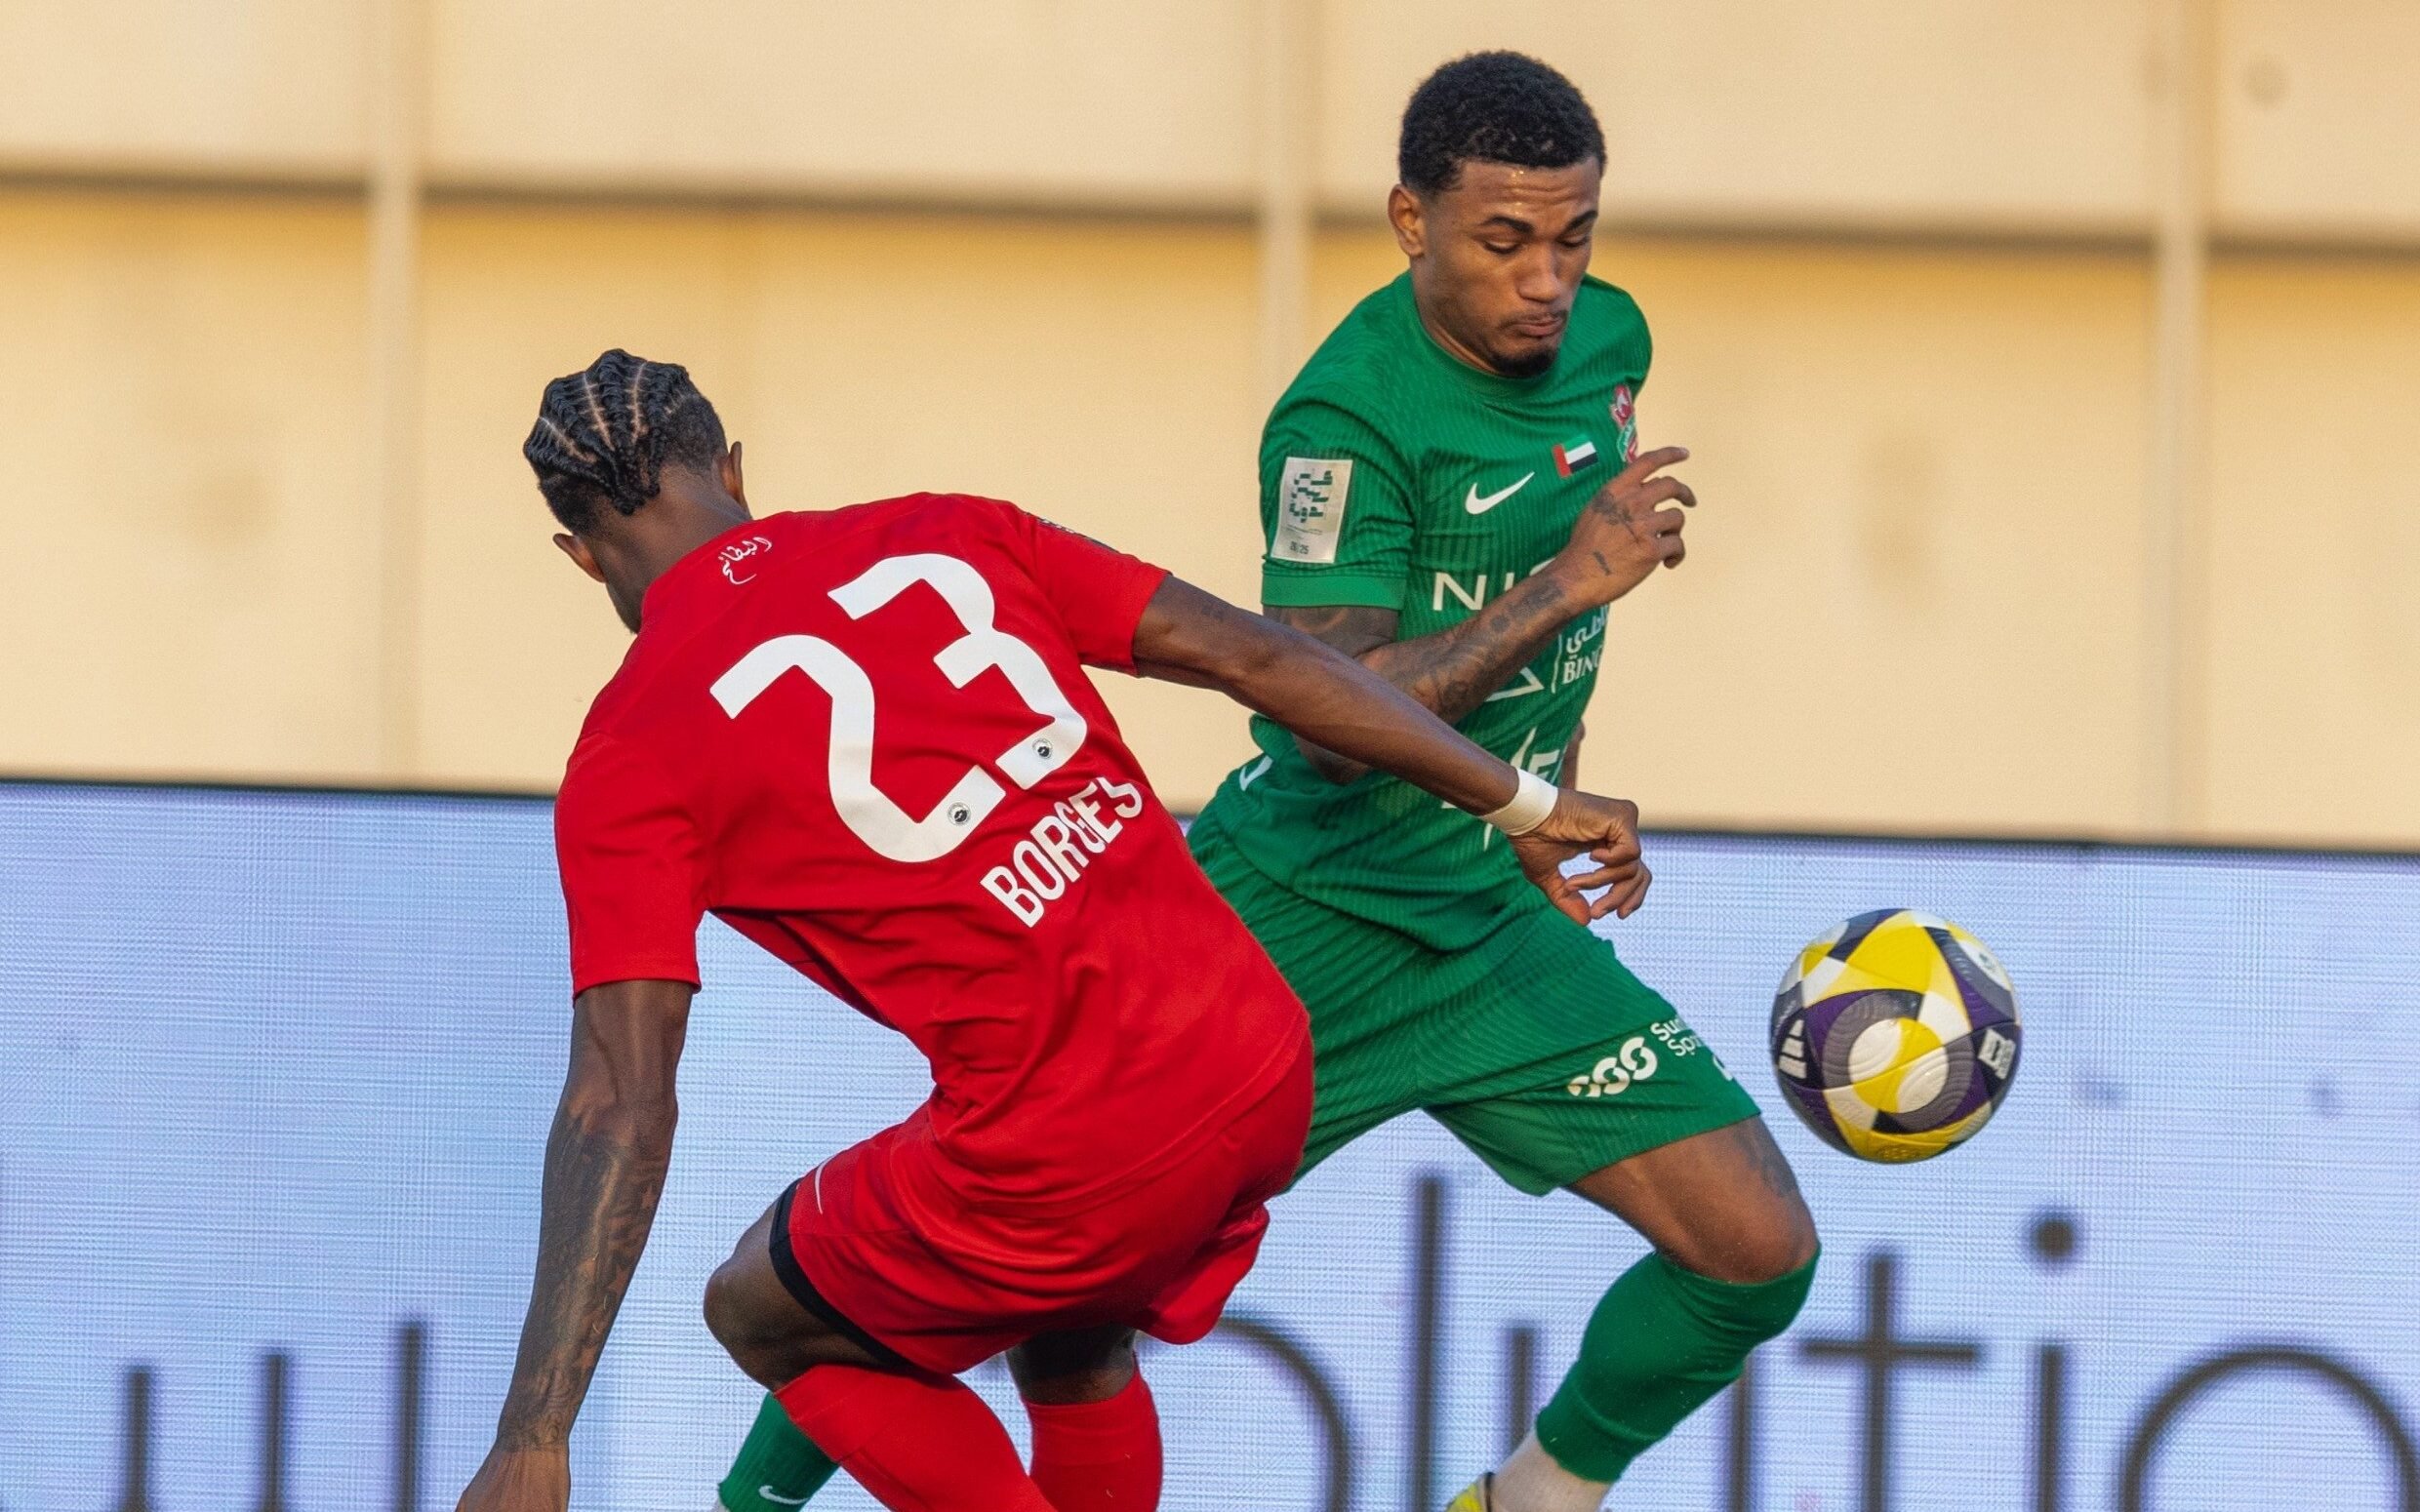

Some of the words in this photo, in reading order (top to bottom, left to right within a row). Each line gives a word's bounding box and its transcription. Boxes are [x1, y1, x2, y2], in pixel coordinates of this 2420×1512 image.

[709, 553, 1088, 863] 23
[1562, 644, 1603, 685] BIN
[980, 776, 1143, 928] BORGES
